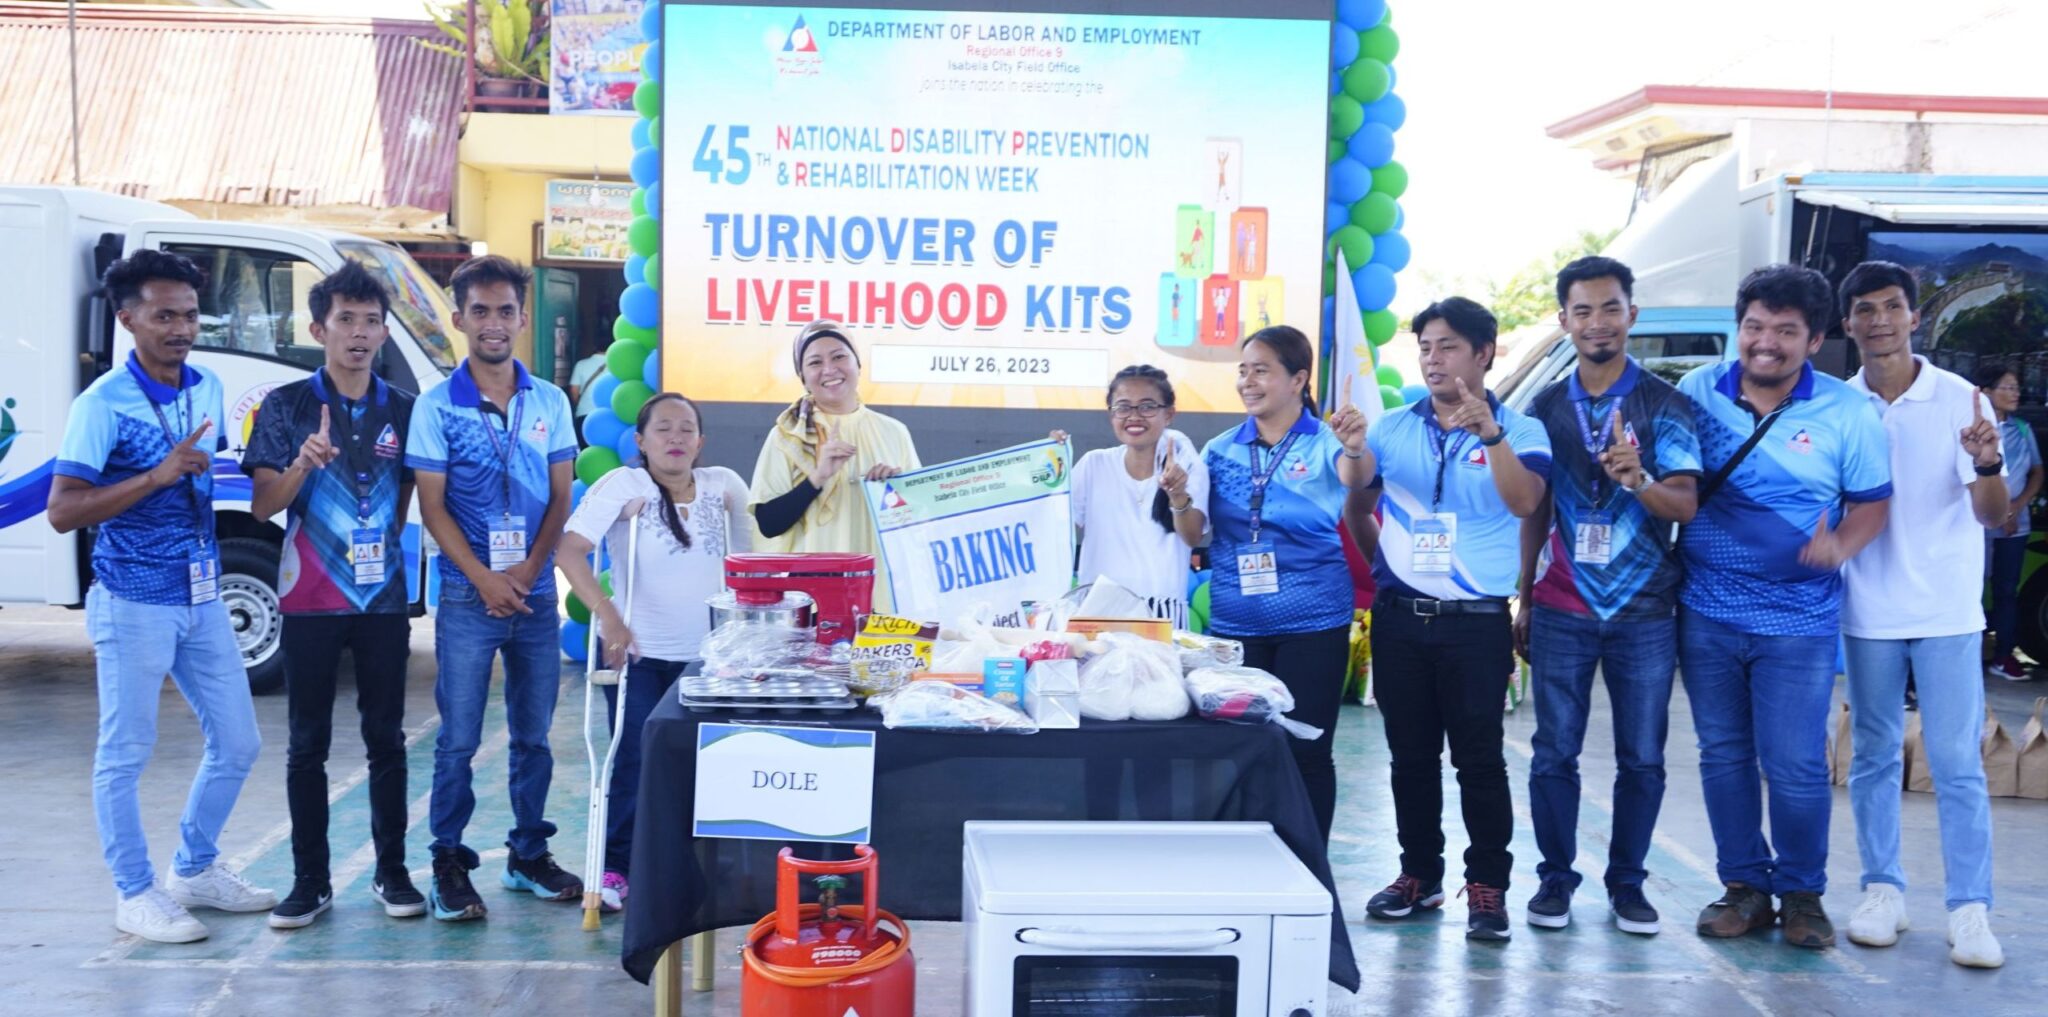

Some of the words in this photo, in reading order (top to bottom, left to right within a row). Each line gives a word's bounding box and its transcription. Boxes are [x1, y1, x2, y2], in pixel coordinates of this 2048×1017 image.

[828, 21, 945, 39] DEPARTMENT
[950, 24, 972, 40] OF
[978, 25, 1035, 42] LABOR
[1041, 26, 1077, 43] AND
[1083, 27, 1202, 46] EMPLOYMENT
[570, 49, 641, 67] PEOPL
[966, 45, 1016, 58] Regional
[1020, 46, 1053, 58] Office
[1056, 47, 1063, 58] 9
[948, 60, 989, 72] Isabela
[992, 61, 1013, 74] City
[1017, 61, 1044, 73] Field
[1048, 62, 1081, 74] Office
[692, 123, 752, 186] 45
[756, 151, 772, 168] TH
[776, 124, 885, 153] NATIONAL
[890, 127, 1006, 156] DISABILITY
[1012, 130, 1150, 159] PREVENTION
[776, 162, 790, 186] &
[795, 162, 970, 190] REHABILITATION
[976, 166, 1039, 193] WEEK
[704, 213, 977, 264] TURNOVER
[993, 219, 1058, 267] OF
[706, 277, 1008, 330] LIVELIHOOD
[1025, 284, 1133, 332] KITS
[929, 355, 970, 374] JULY
[974, 357, 1001, 375] 26,
[1008, 358, 1051, 375] 2023
[234, 395, 256, 421] CITY
[904, 473, 945, 488] DEPARTMENT
[991, 454, 1031, 469] EMPLOYMENT
[929, 521, 1037, 593] BAKING
[851, 643, 913, 660] BAKERS
[752, 770, 818, 791] DOLE
